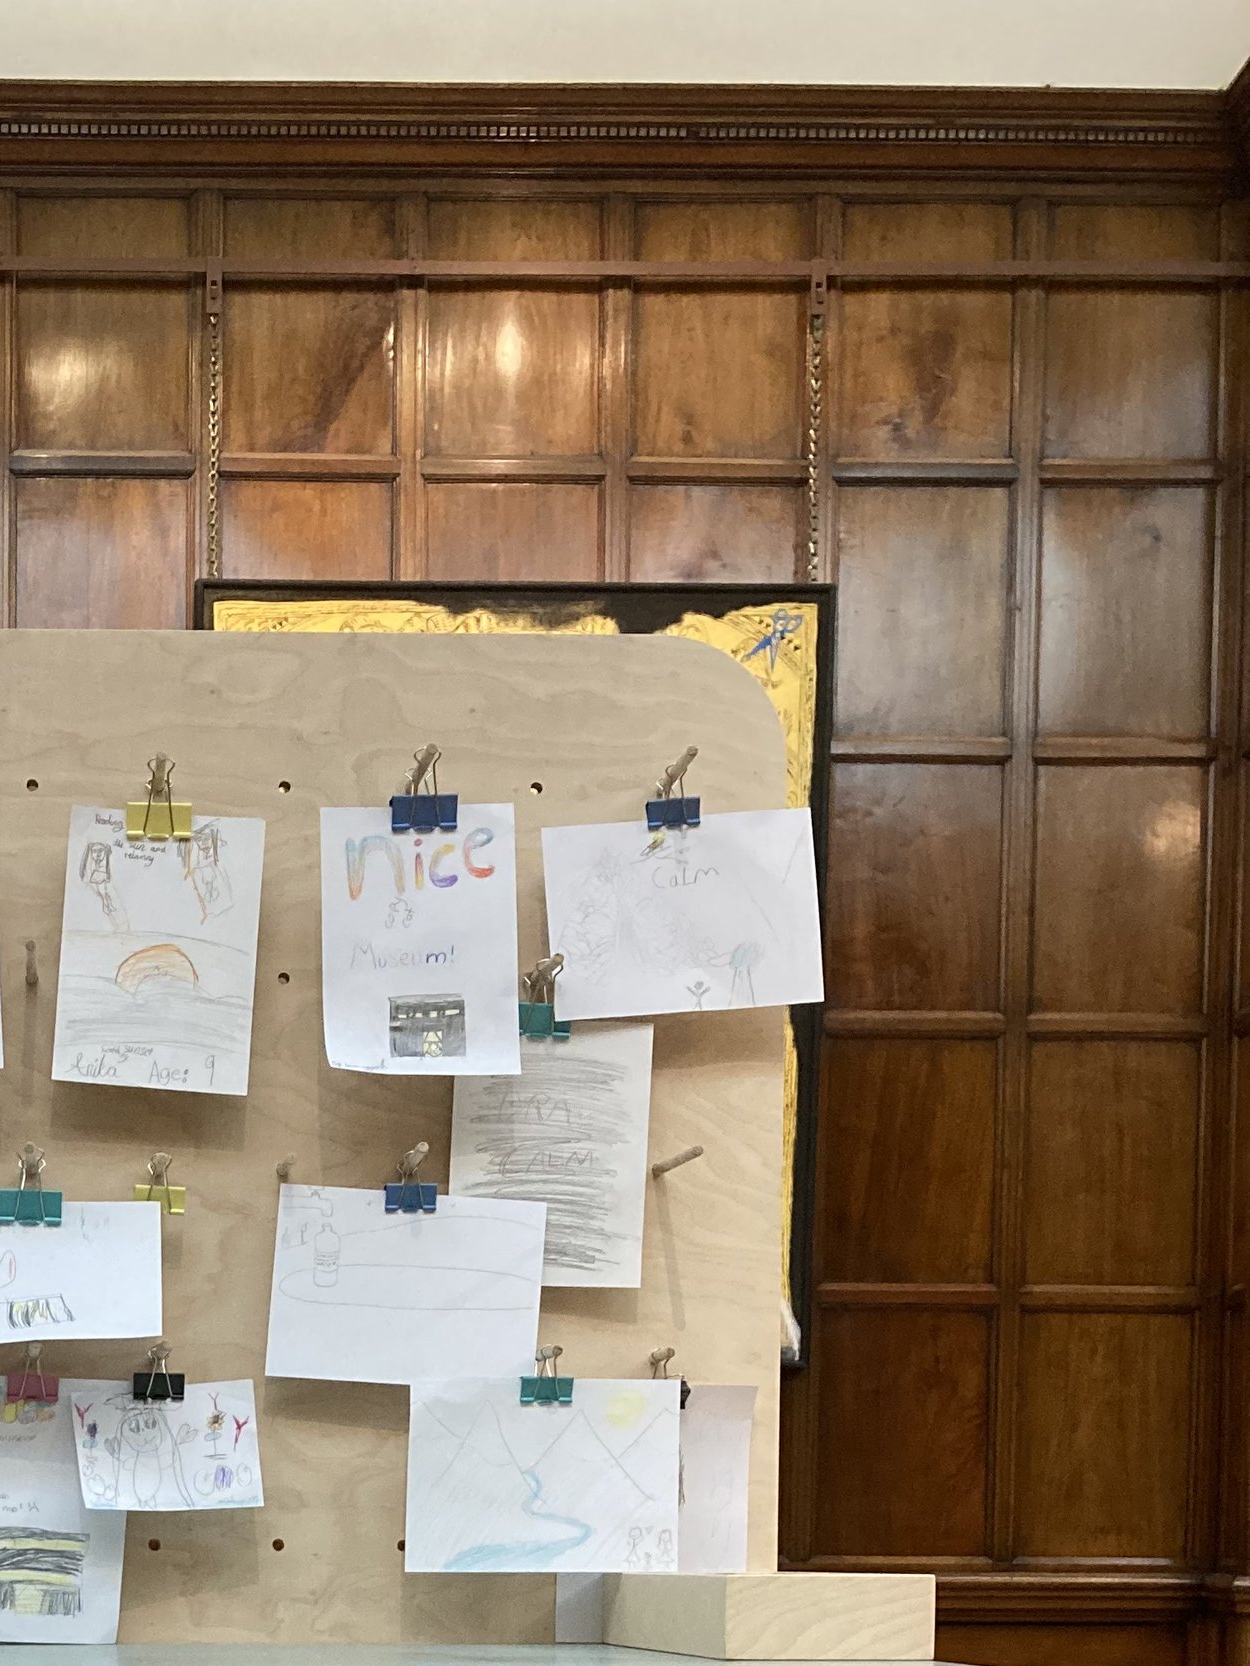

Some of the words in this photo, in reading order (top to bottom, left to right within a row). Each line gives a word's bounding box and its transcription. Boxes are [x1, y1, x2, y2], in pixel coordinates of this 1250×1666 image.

[345, 827, 495, 901] nice
[148, 1060, 190, 1086] Age:
[204, 1054, 216, 1088] 9
